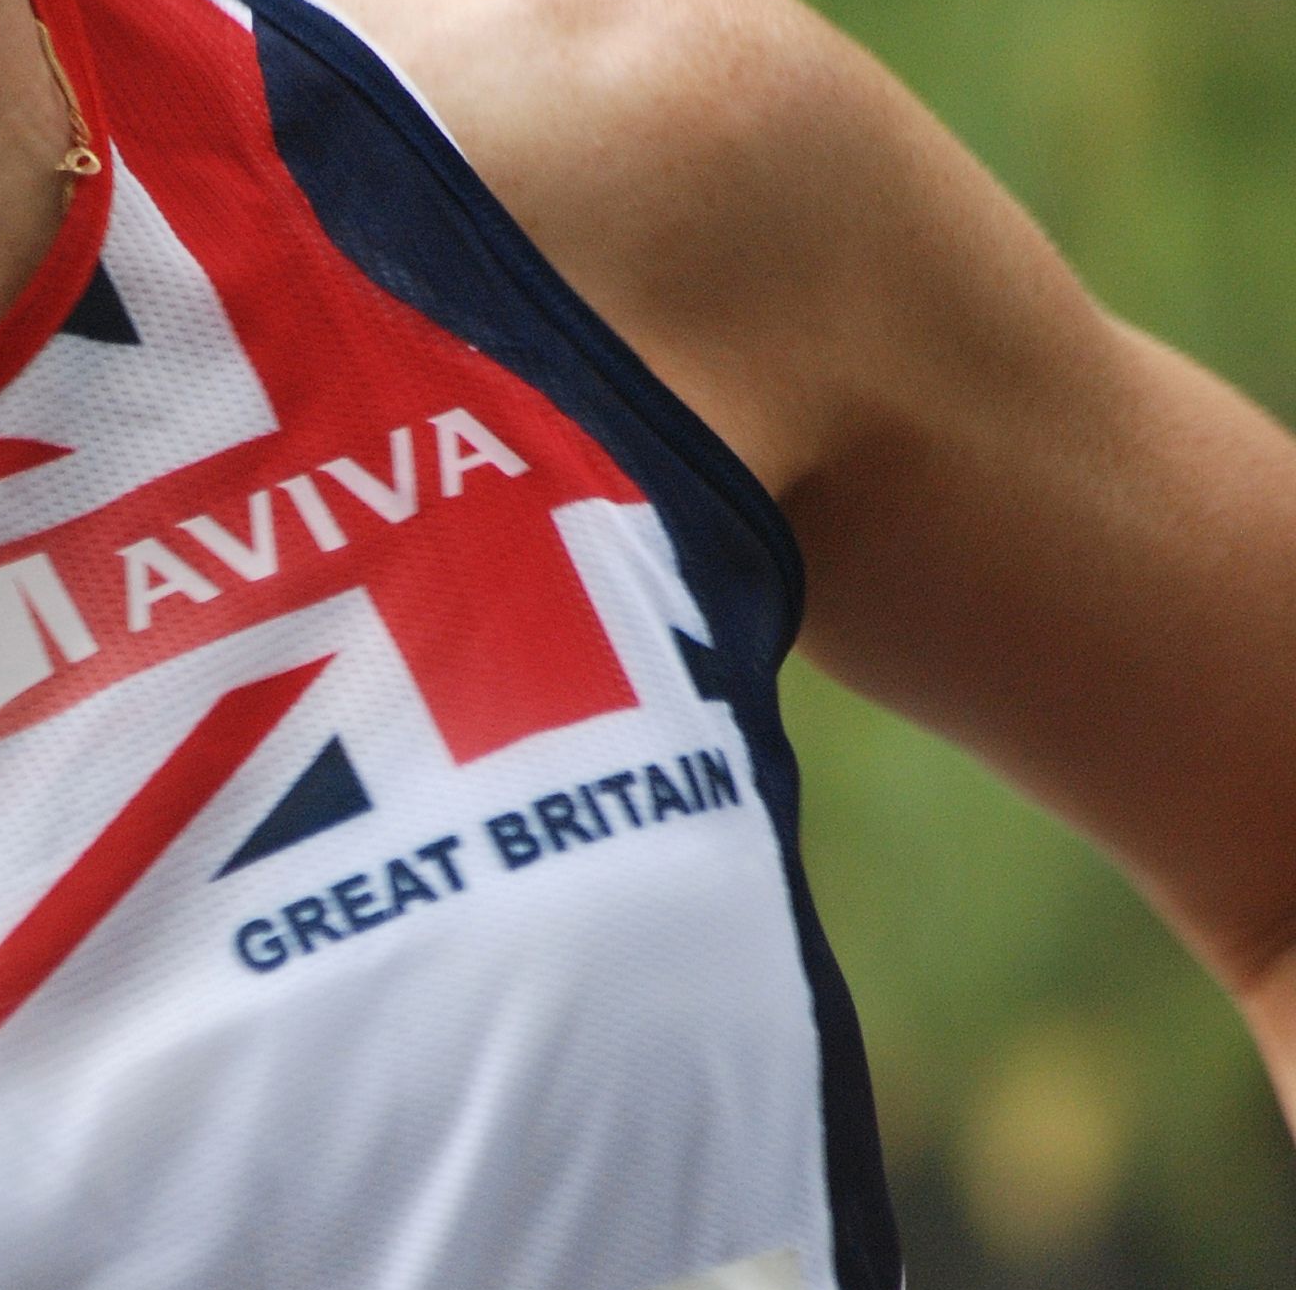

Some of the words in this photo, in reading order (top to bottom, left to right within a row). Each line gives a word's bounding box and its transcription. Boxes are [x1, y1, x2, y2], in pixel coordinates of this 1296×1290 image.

[115, 406, 532, 634] AVIVA
[233, 834, 466, 974] GREAT
[483, 747, 742, 871] BRITAIN
